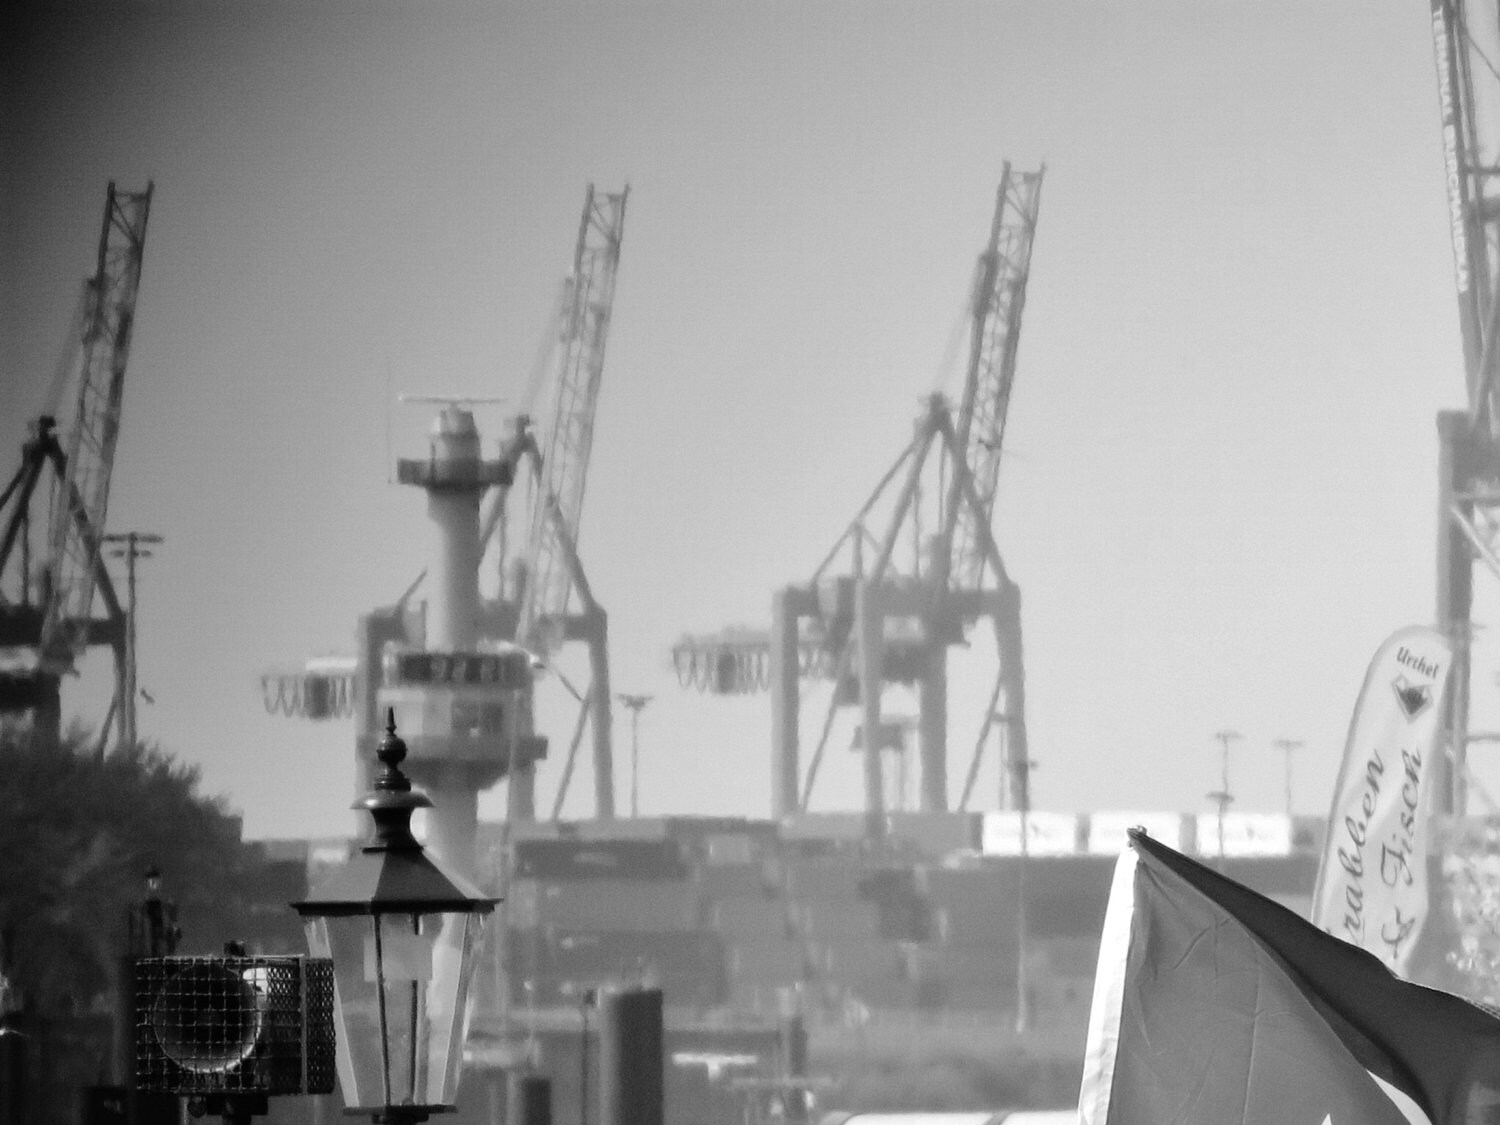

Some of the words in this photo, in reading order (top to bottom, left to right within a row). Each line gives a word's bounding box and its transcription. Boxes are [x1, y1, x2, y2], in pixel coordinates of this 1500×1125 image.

[1396, 646, 1440, 680] Urthel
[1336, 748, 1385, 945] rabben
[1380, 748, 1422, 888] Fisch
